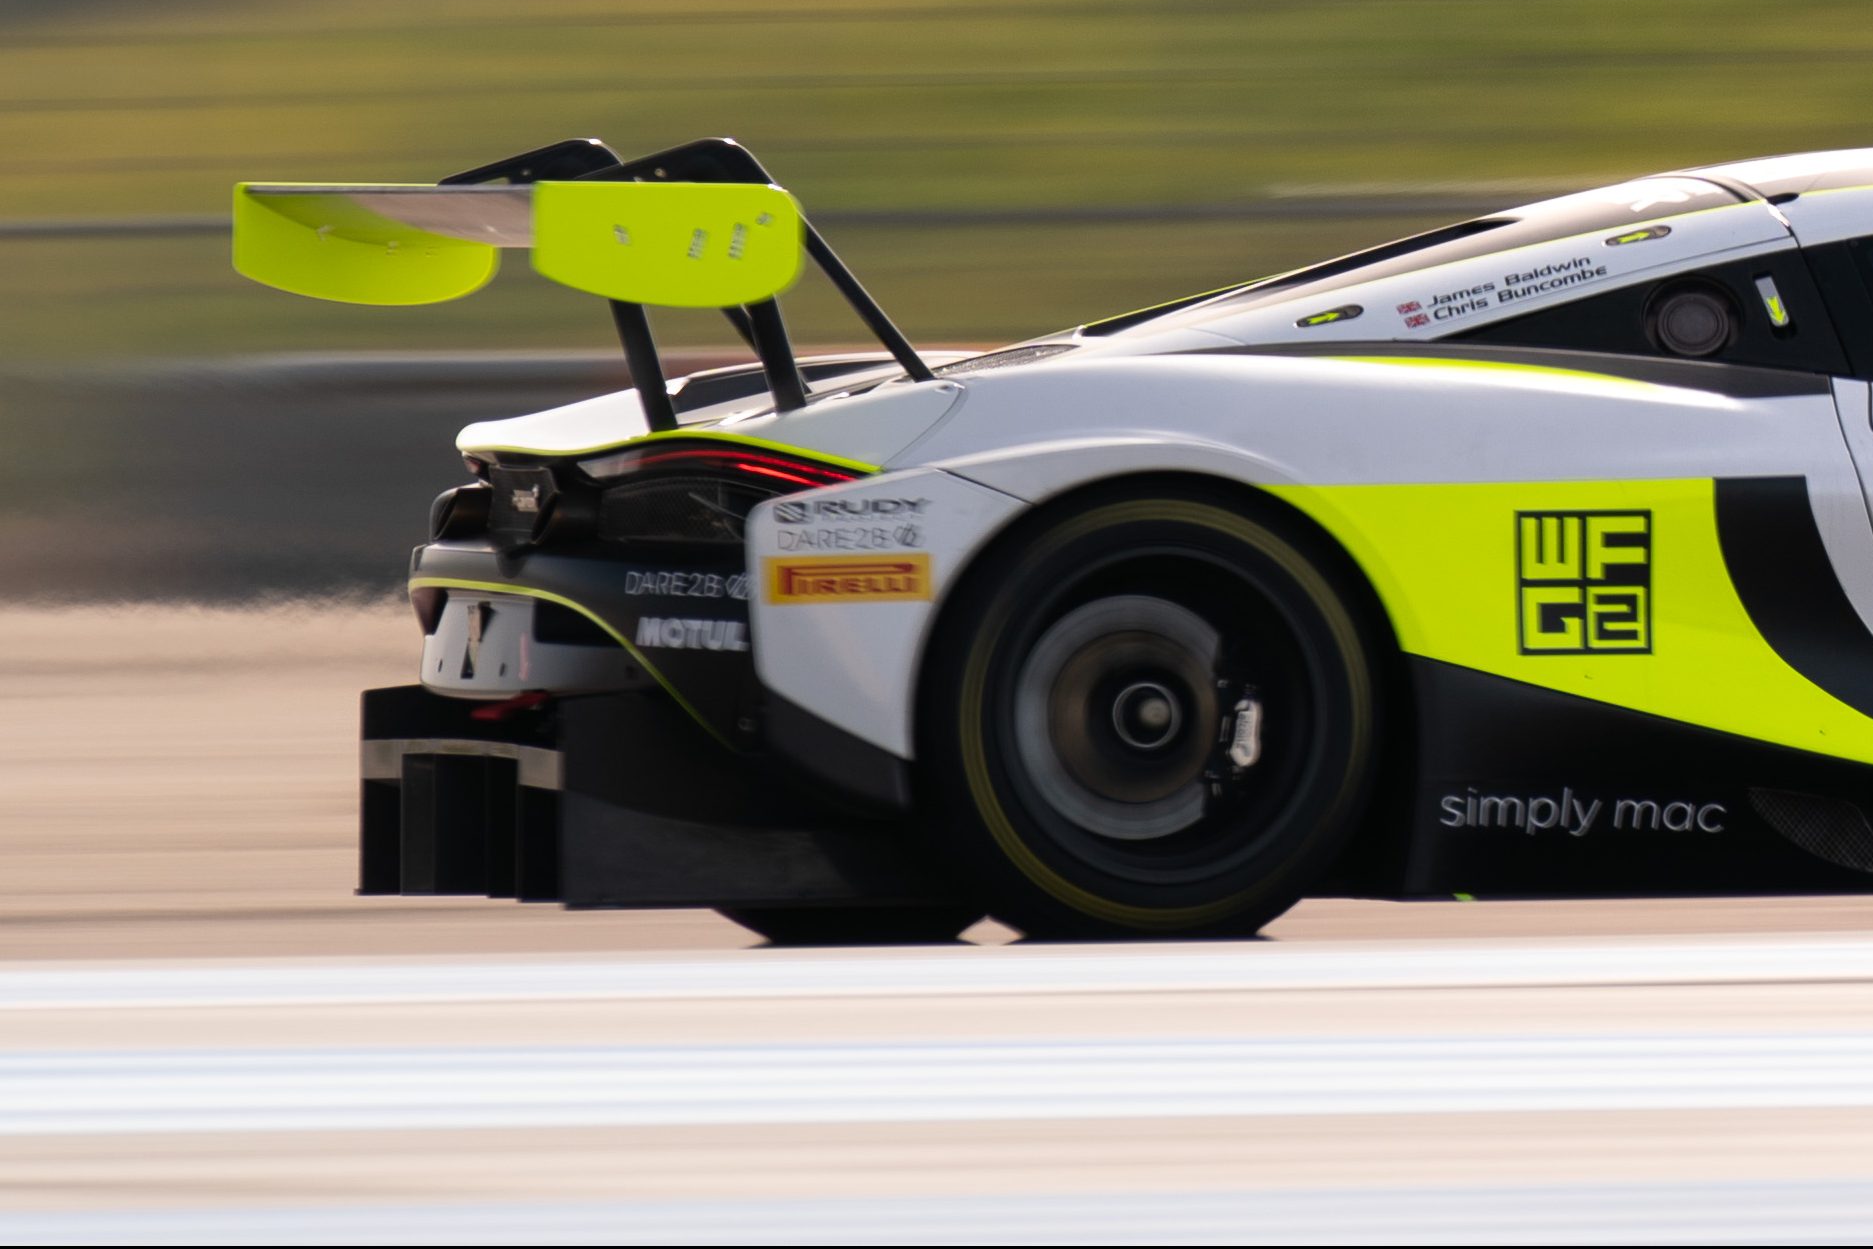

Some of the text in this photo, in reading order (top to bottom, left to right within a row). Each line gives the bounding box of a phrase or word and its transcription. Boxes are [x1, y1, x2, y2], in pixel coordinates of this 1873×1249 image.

[1428, 256, 1591, 306] James Baldwin
[1433, 265, 1607, 320] Chris Buncombe
[813, 498, 932, 516] RUDY
[625, 571, 724, 597] DARE2B
[777, 563, 918, 596] PIRELLI
[636, 616, 748, 651] MOTUL
[1440, 786, 1727, 836] simply mac
